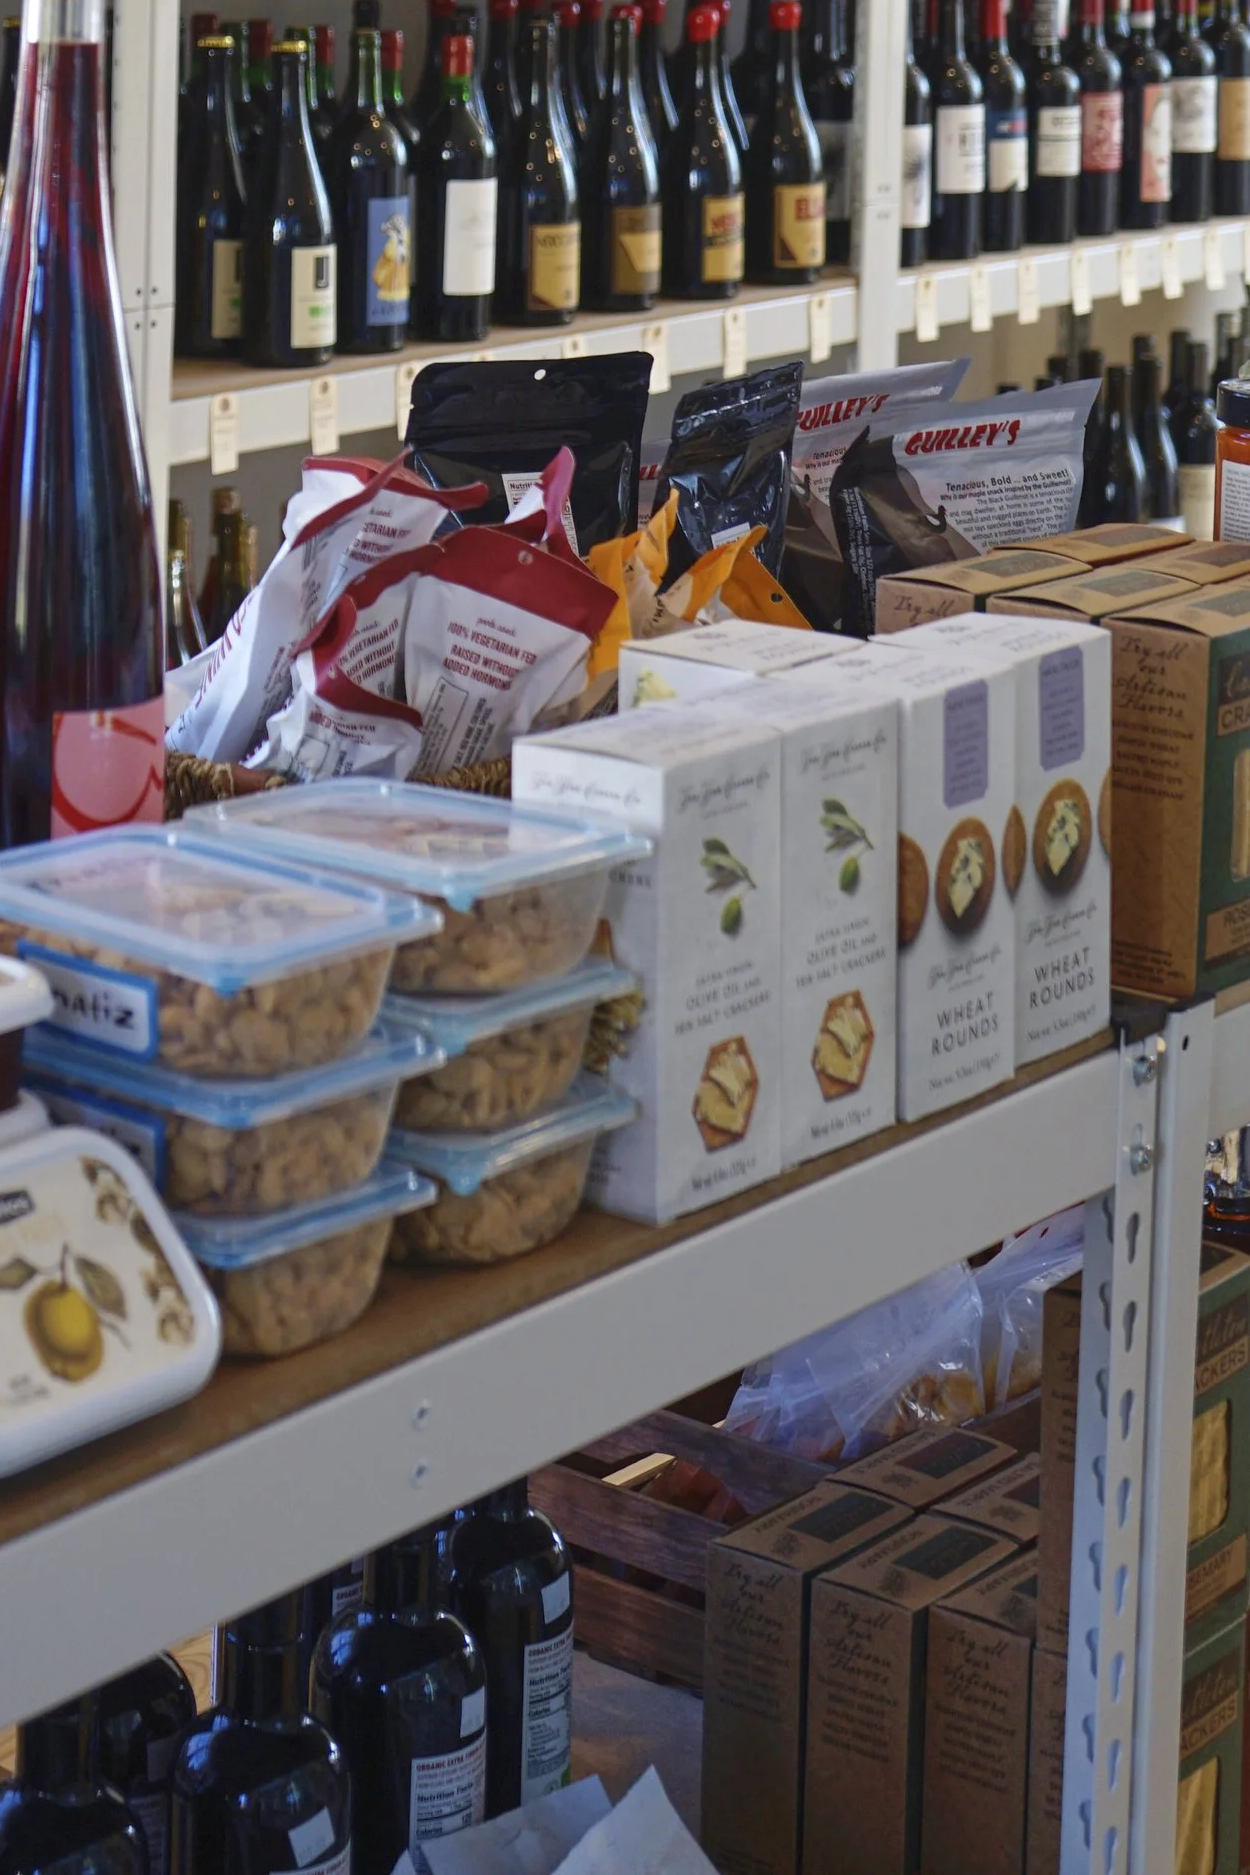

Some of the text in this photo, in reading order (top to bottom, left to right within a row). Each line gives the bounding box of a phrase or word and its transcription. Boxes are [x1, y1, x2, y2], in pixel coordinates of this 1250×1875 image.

[904, 419, 1022, 456] GUILLEY'S
[509, 481, 535, 490] Nutriti
[946, 467, 1069, 493] Tenacious, Bold and Sweet!
[969, 490, 986, 499] maple
[987, 487, 1004, 496] snack
[1032, 482, 1042, 490] the
[988, 496, 1004, 504] Black
[451, 643, 522, 679] RAISED WITHOUT
[470, 629, 521, 661] VEGETARIAN
[521, 650, 538, 666] FED
[443, 656, 471, 677] ADDED
[1220, 707, 1250, 730] CRA
[806, 945, 838, 966] OLIVE
[839, 938, 858, 956] OIL
[1034, 945, 1090, 985] WHEAT
[686, 989, 719, 1012] OLIVE
[722, 982, 741, 999] OIL
[1028, 966, 1096, 1011] ROUNDS
[936, 990, 994, 1031] WHEAT
[930, 1012, 1000, 1058] ROUNDS
[1194, 1345, 1248, 1391] ACKERS
[1181, 1695, 1238, 1751] ACKERS
[416, 1761, 446, 1772] ORGANIC
[417, 1788, 455, 1804] Nutrition
